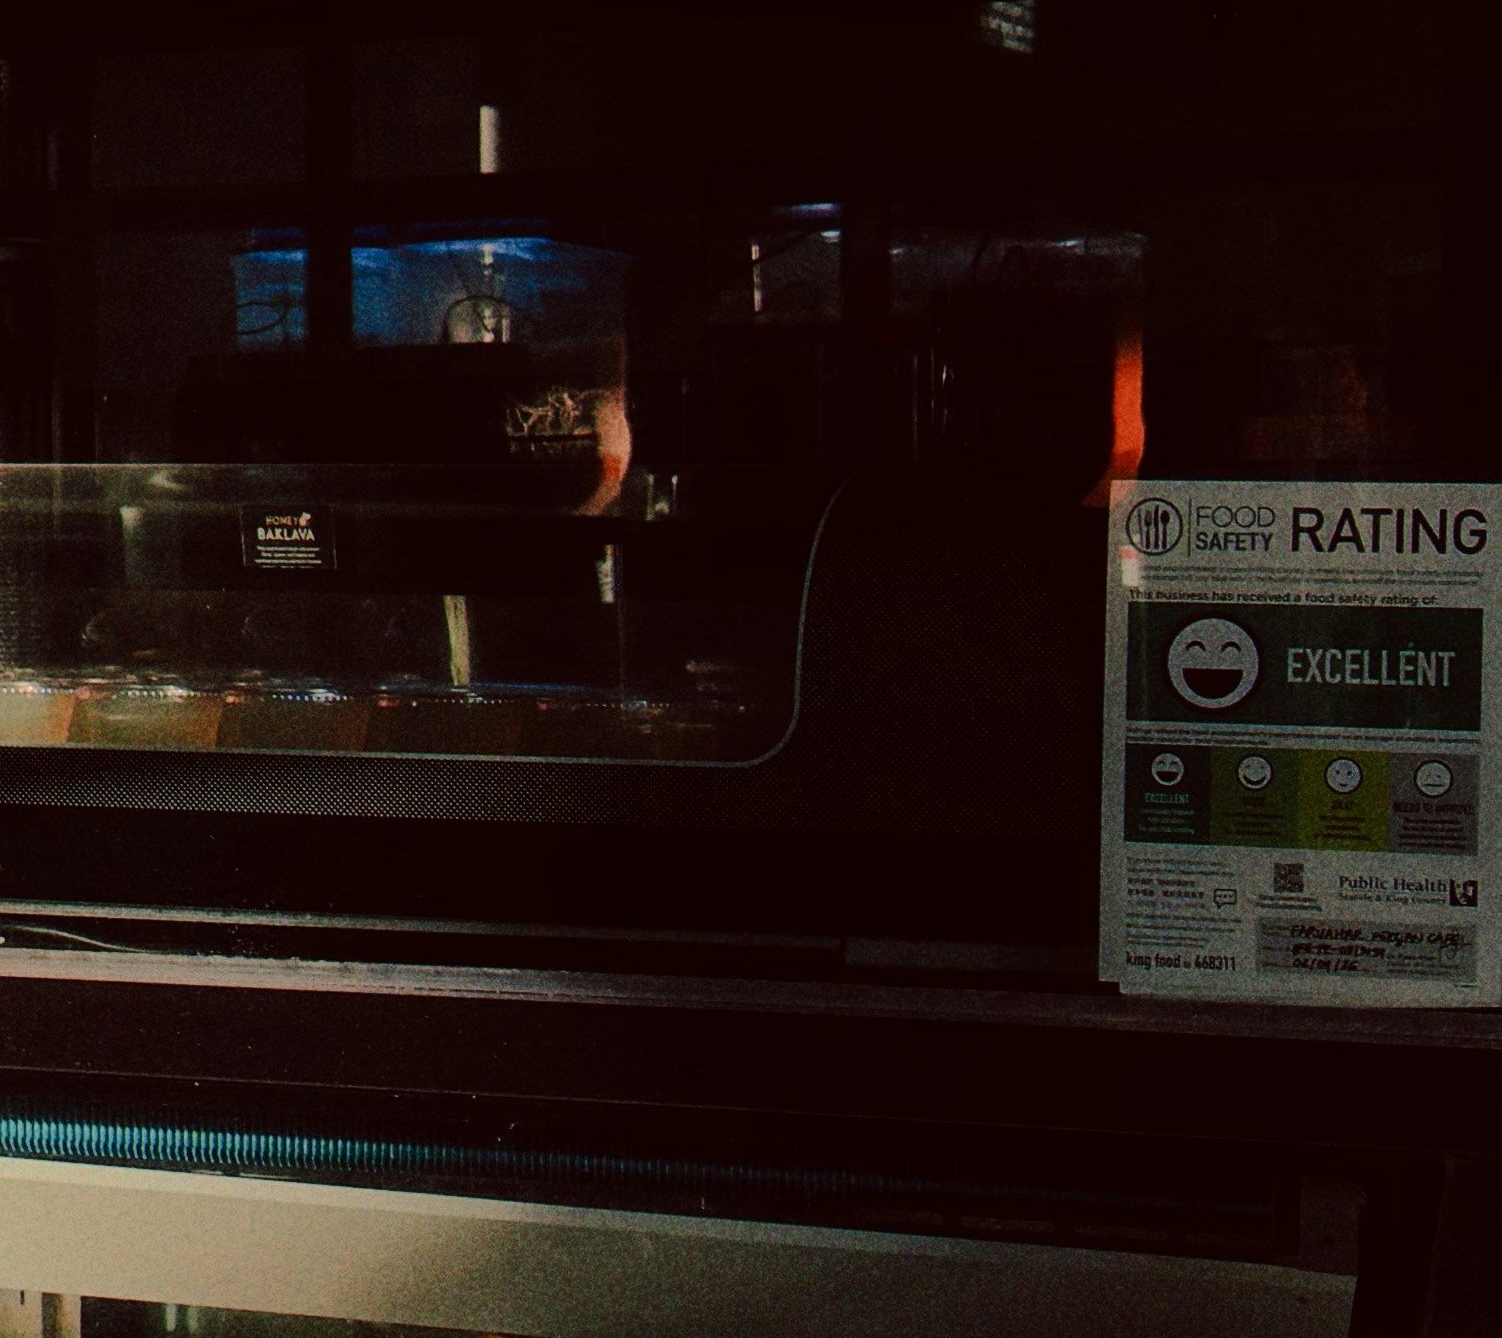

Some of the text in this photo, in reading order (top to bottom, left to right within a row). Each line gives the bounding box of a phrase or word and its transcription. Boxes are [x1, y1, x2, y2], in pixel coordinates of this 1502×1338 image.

[265, 515, 298, 526] HONEY
[1195, 505, 1276, 528] FOOD
[256, 526, 316, 541] BAKLAVA
[1291, 506, 1488, 556] RATING
[1195, 531, 1273, 552] SAFETY
[1129, 588, 1152, 601] This
[1156, 589, 1209, 601] business
[1212, 590, 1234, 601] has
[1237, 591, 1291, 603] received
[1305, 593, 1335, 603] food
[1338, 593, 1376, 606] safety
[1381, 595, 1418, 607] rating
[1285, 646, 1457, 688] EXCELLENT
[1339, 875, 1448, 893] Public Health
